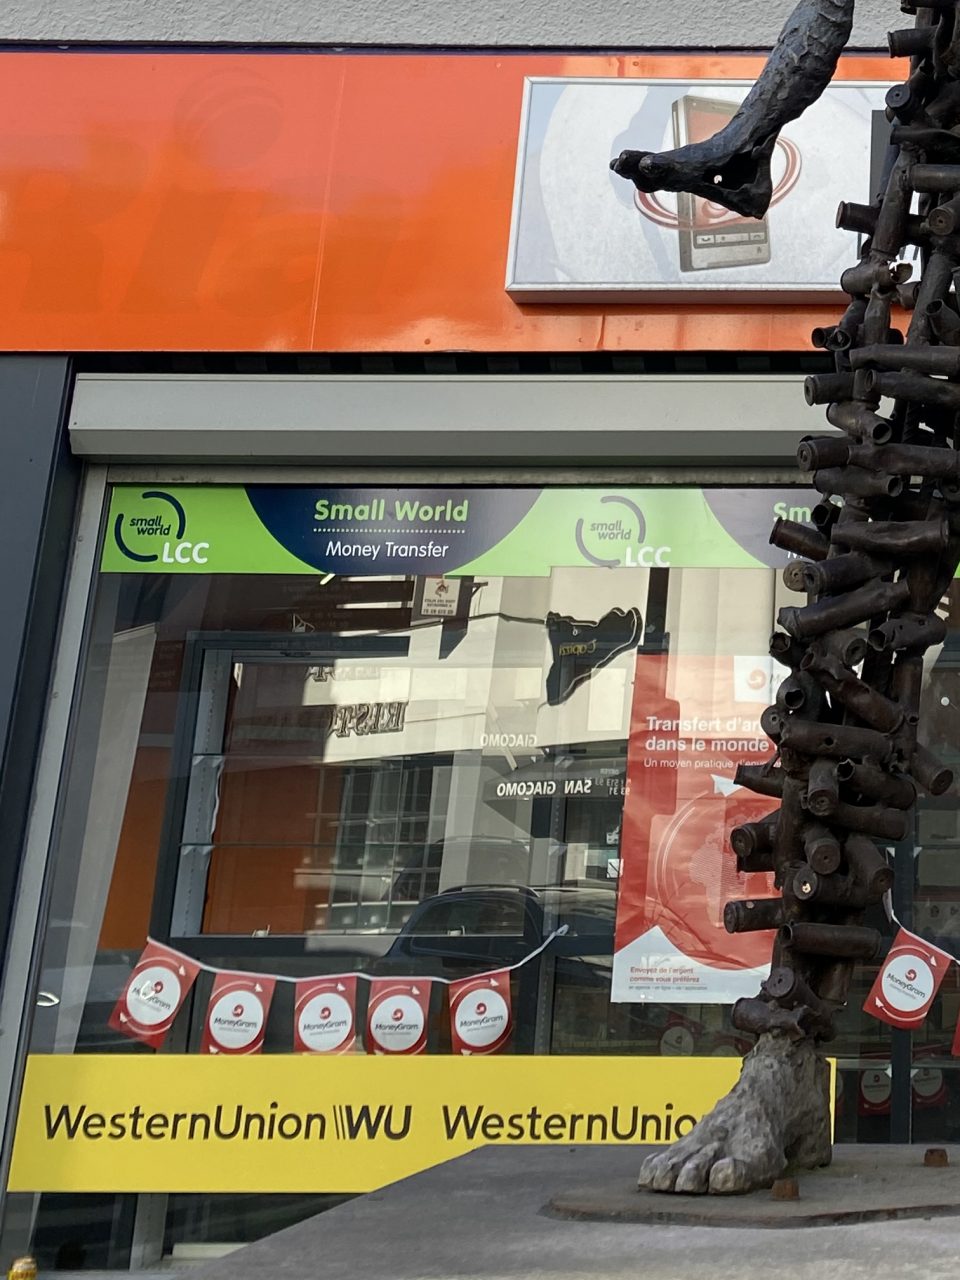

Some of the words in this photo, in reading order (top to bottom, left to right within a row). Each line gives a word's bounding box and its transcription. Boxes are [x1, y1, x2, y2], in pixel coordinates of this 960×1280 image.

[314, 499, 385, 521] Small
[394, 499, 469, 522] World
[129, 516, 162, 527] small
[590, 520, 622, 532] small
[136, 524, 171, 536] world
[598, 528, 632, 541] world
[162, 542, 210, 564] LCC
[325, 540, 381, 560] Money
[385, 541, 449, 558] Transfer
[625, 546, 672, 567] LCC
[645, 716, 721, 732] Transfert
[727, 716, 761, 732] d'ar
[645, 736, 686, 752] dans
[692, 736, 706, 752] le
[711, 736, 769, 752] monde
[644, 758, 658, 768] Un
[660, 760, 692, 771] moyen
[694, 758, 734, 771] pratique
[887, 972, 926, 999] MoneyGram
[214, 1017, 258, 1029] MoneyGram
[303, 1019, 347, 1031] MoneyGram
[375, 1022, 419, 1032] MoneyGram
[460, 1014, 504, 1029] MoneyGram
[44, 1102, 327, 1141] WesternUnion
[442, 1103, 703, 1141] WesternUnio
